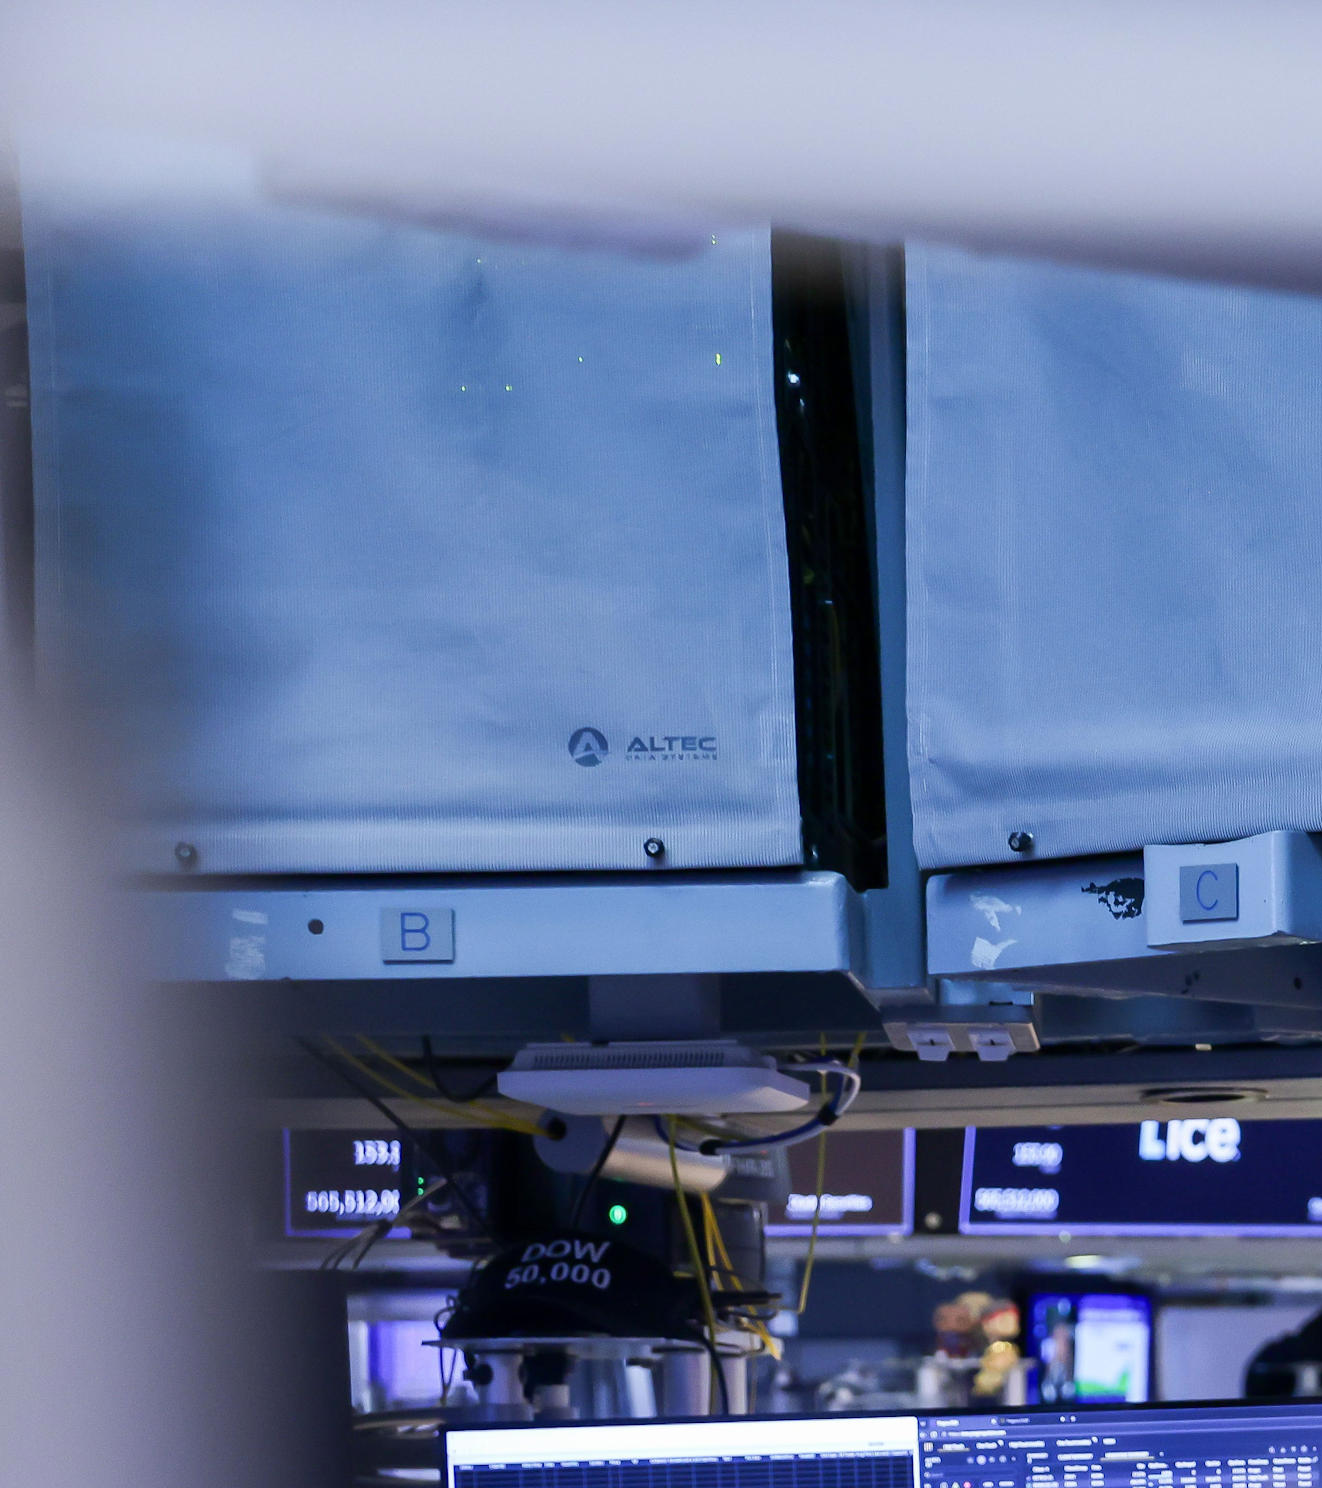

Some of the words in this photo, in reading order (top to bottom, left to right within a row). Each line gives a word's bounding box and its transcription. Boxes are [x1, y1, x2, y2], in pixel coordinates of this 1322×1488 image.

[627, 736, 717, 752] ALTEC
[1196, 869, 1219, 911] C
[400, 913, 430, 951] B
[521, 1240, 611, 1264] DOW
